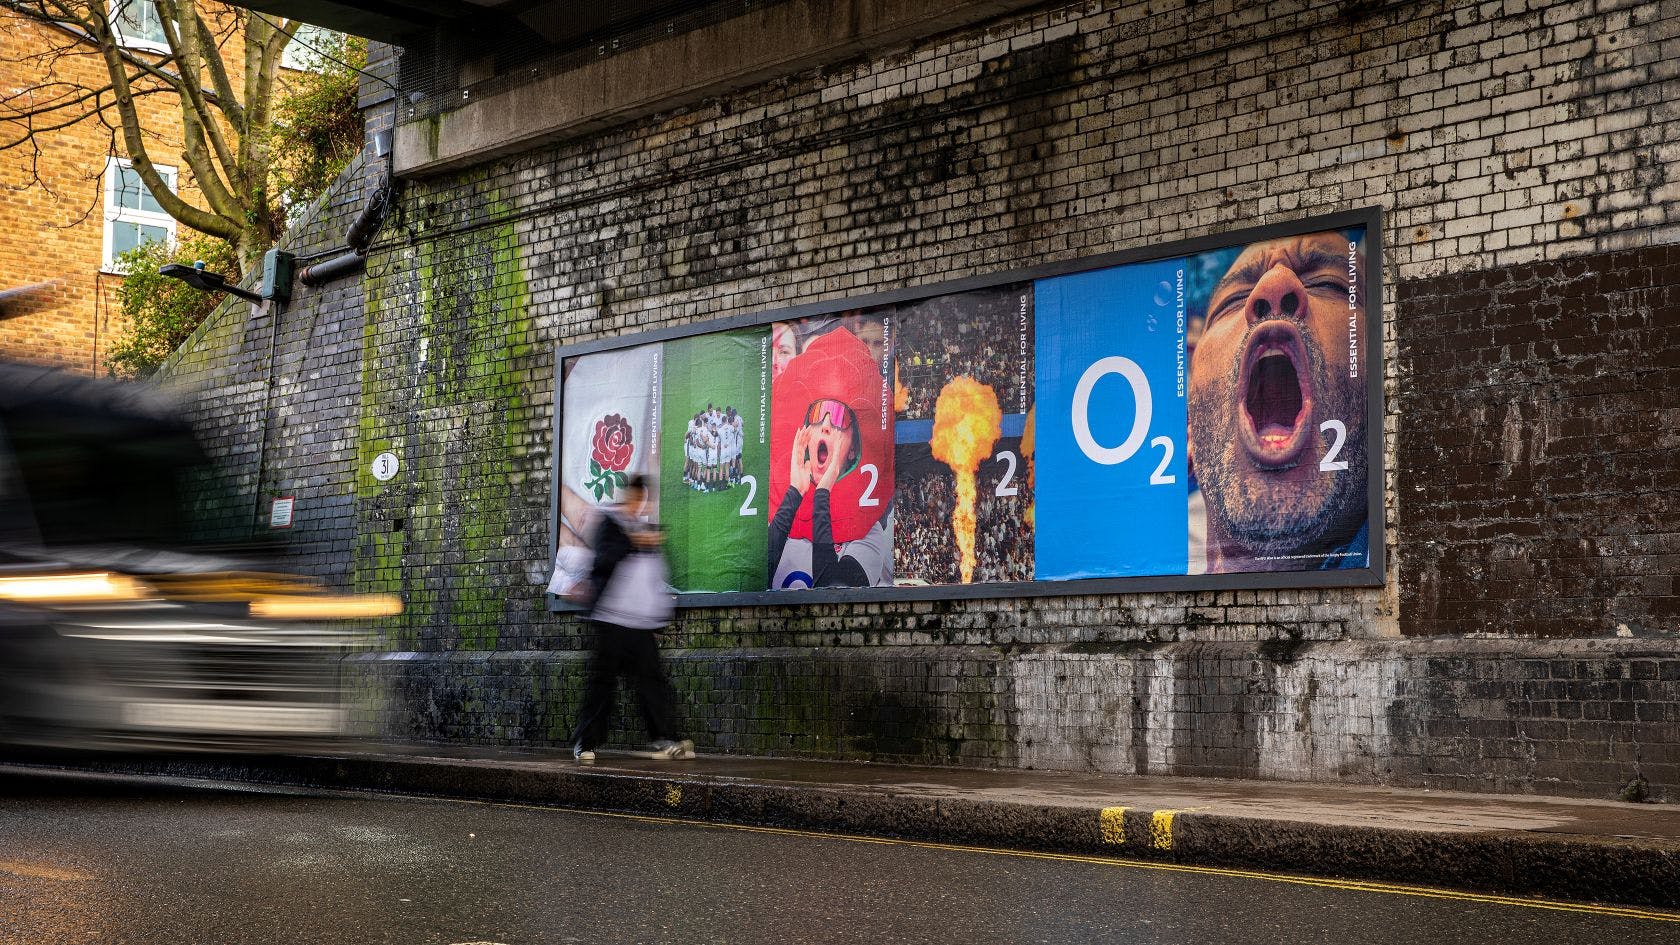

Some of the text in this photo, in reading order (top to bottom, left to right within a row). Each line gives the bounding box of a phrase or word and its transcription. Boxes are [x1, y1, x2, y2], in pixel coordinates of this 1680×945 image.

[1176, 269, 1184, 398] ESSENTIAL FOR LIVING
[1348, 241, 1358, 378] ESSENTIAL FOR LIVING
[1019, 357, 1027, 415] ESSENTIAL
[379, 459, 389, 475] 31
[1319, 419, 1349, 472] 2
[739, 474, 758, 516] 2
[858, 463, 880, 507] 2
[995, 450, 1018, 497] 2
